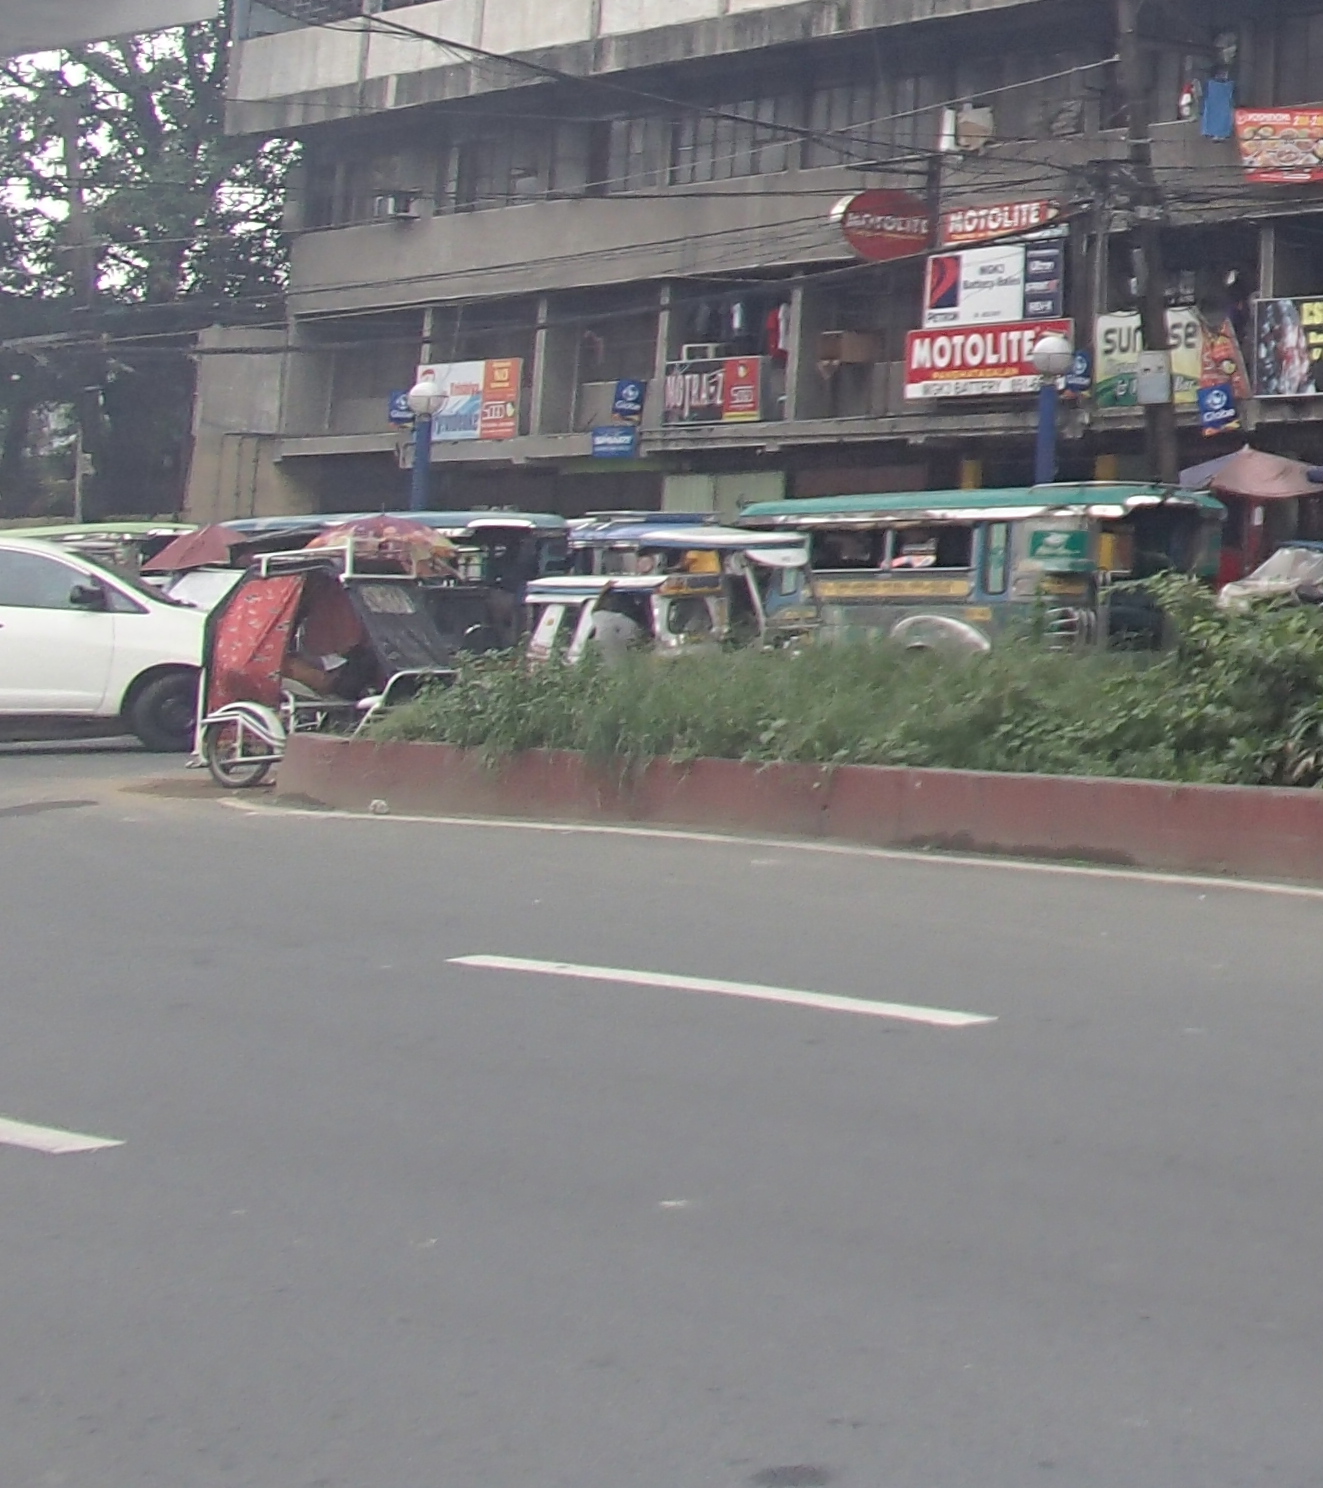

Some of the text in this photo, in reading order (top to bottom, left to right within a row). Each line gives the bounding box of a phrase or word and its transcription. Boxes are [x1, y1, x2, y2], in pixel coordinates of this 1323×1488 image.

[949, 202, 1042, 233] MOTOLITE
[911, 329, 1035, 370] MOTOLITE
[1203, 408, 1236, 423] Globe
